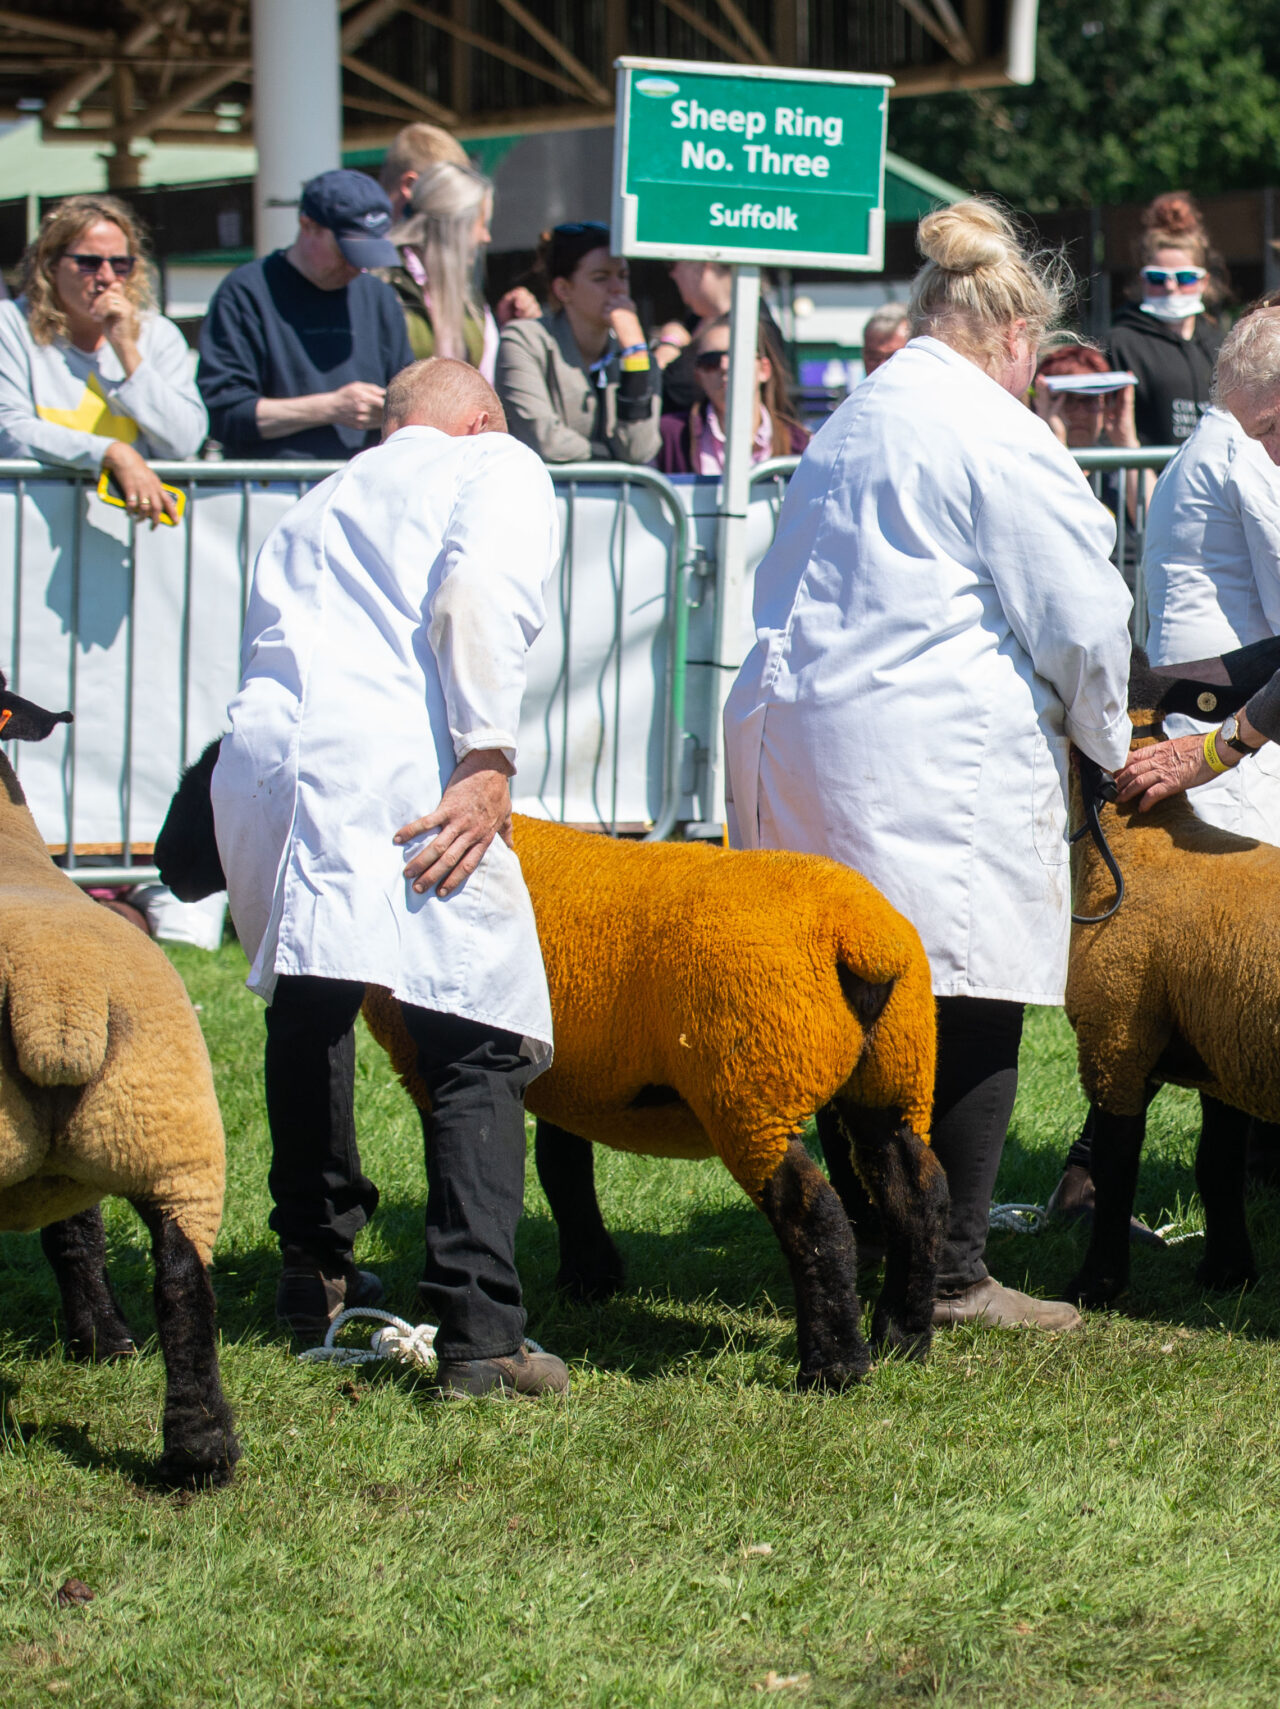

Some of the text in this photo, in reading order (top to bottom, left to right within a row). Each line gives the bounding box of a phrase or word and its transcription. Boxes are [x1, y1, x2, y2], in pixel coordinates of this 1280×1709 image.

[671, 99, 844, 146] Sheep Ring
[681, 140, 830, 178] No. Three
[709, 202, 799, 231] Suffolk
